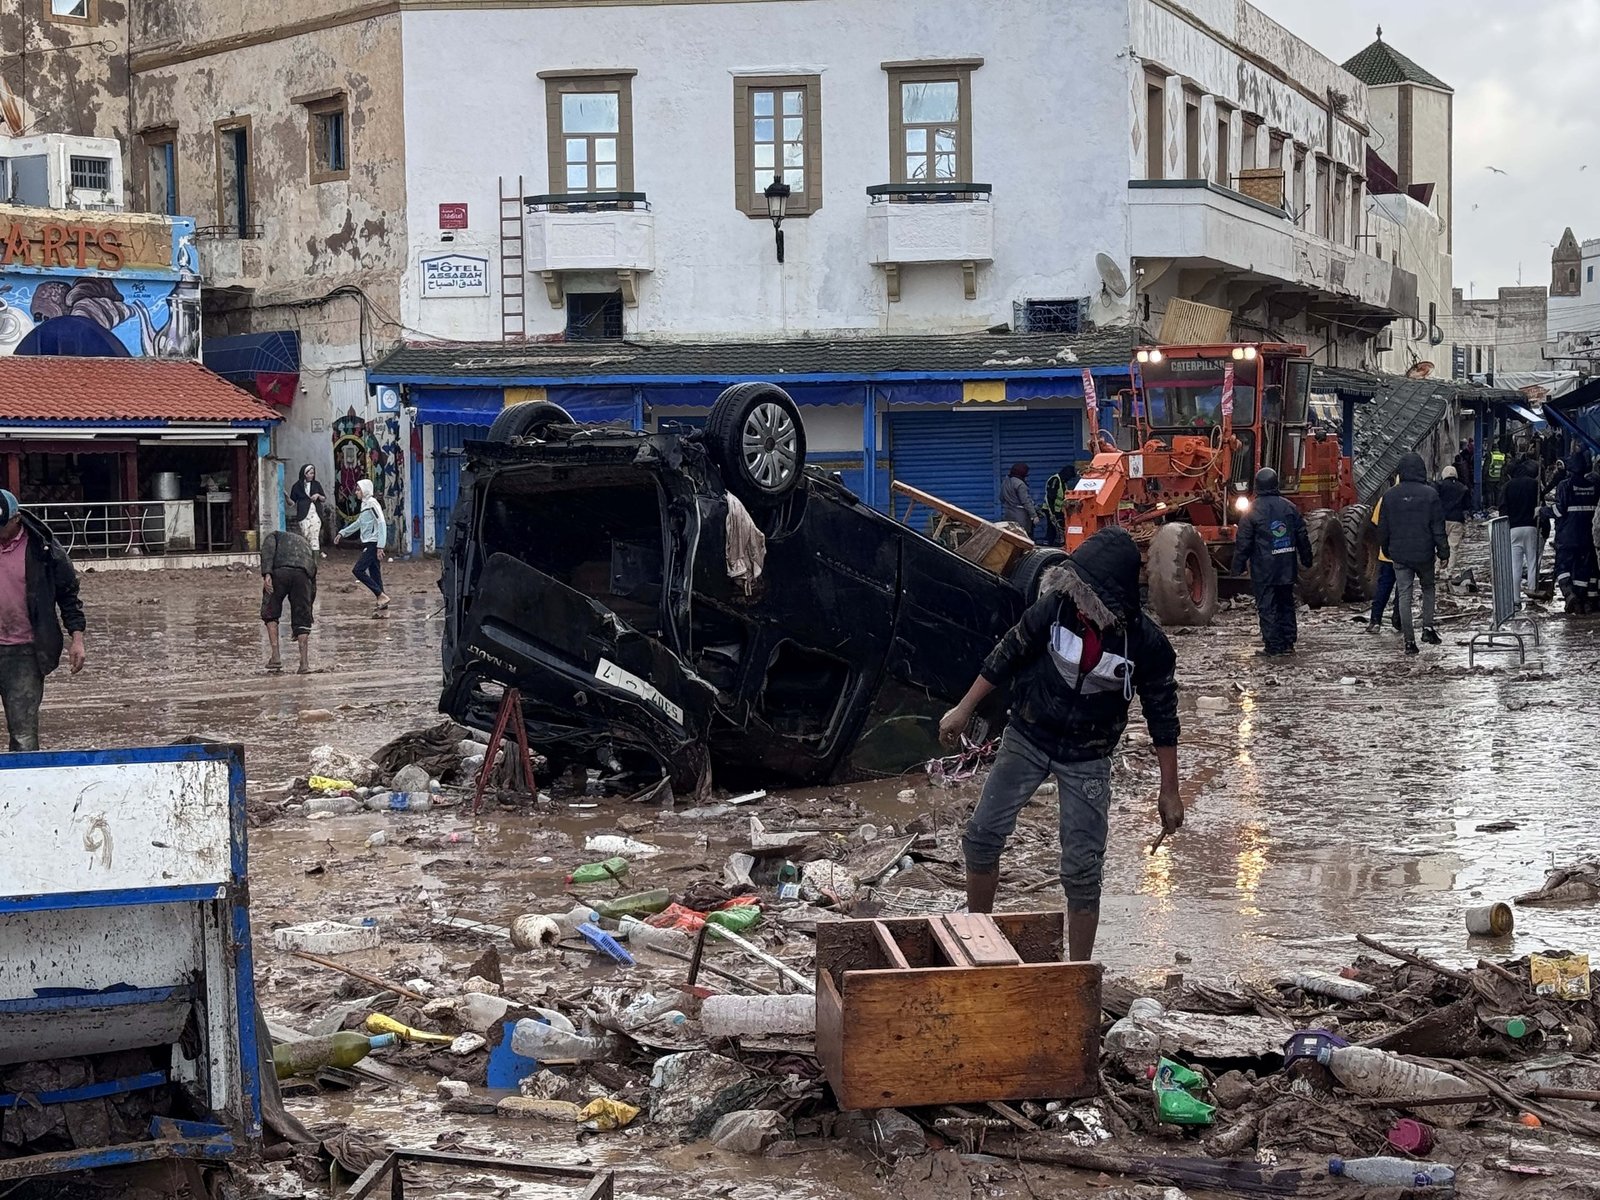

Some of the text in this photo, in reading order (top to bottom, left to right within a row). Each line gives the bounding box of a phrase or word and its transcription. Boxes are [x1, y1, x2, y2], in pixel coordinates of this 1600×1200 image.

[1, 223, 125, 271] ARTS
[427, 262, 482, 272] HÔTEL
[458, 279, 482, 289] فندق
[1171, 360, 1225, 372] CATERPILLAR
